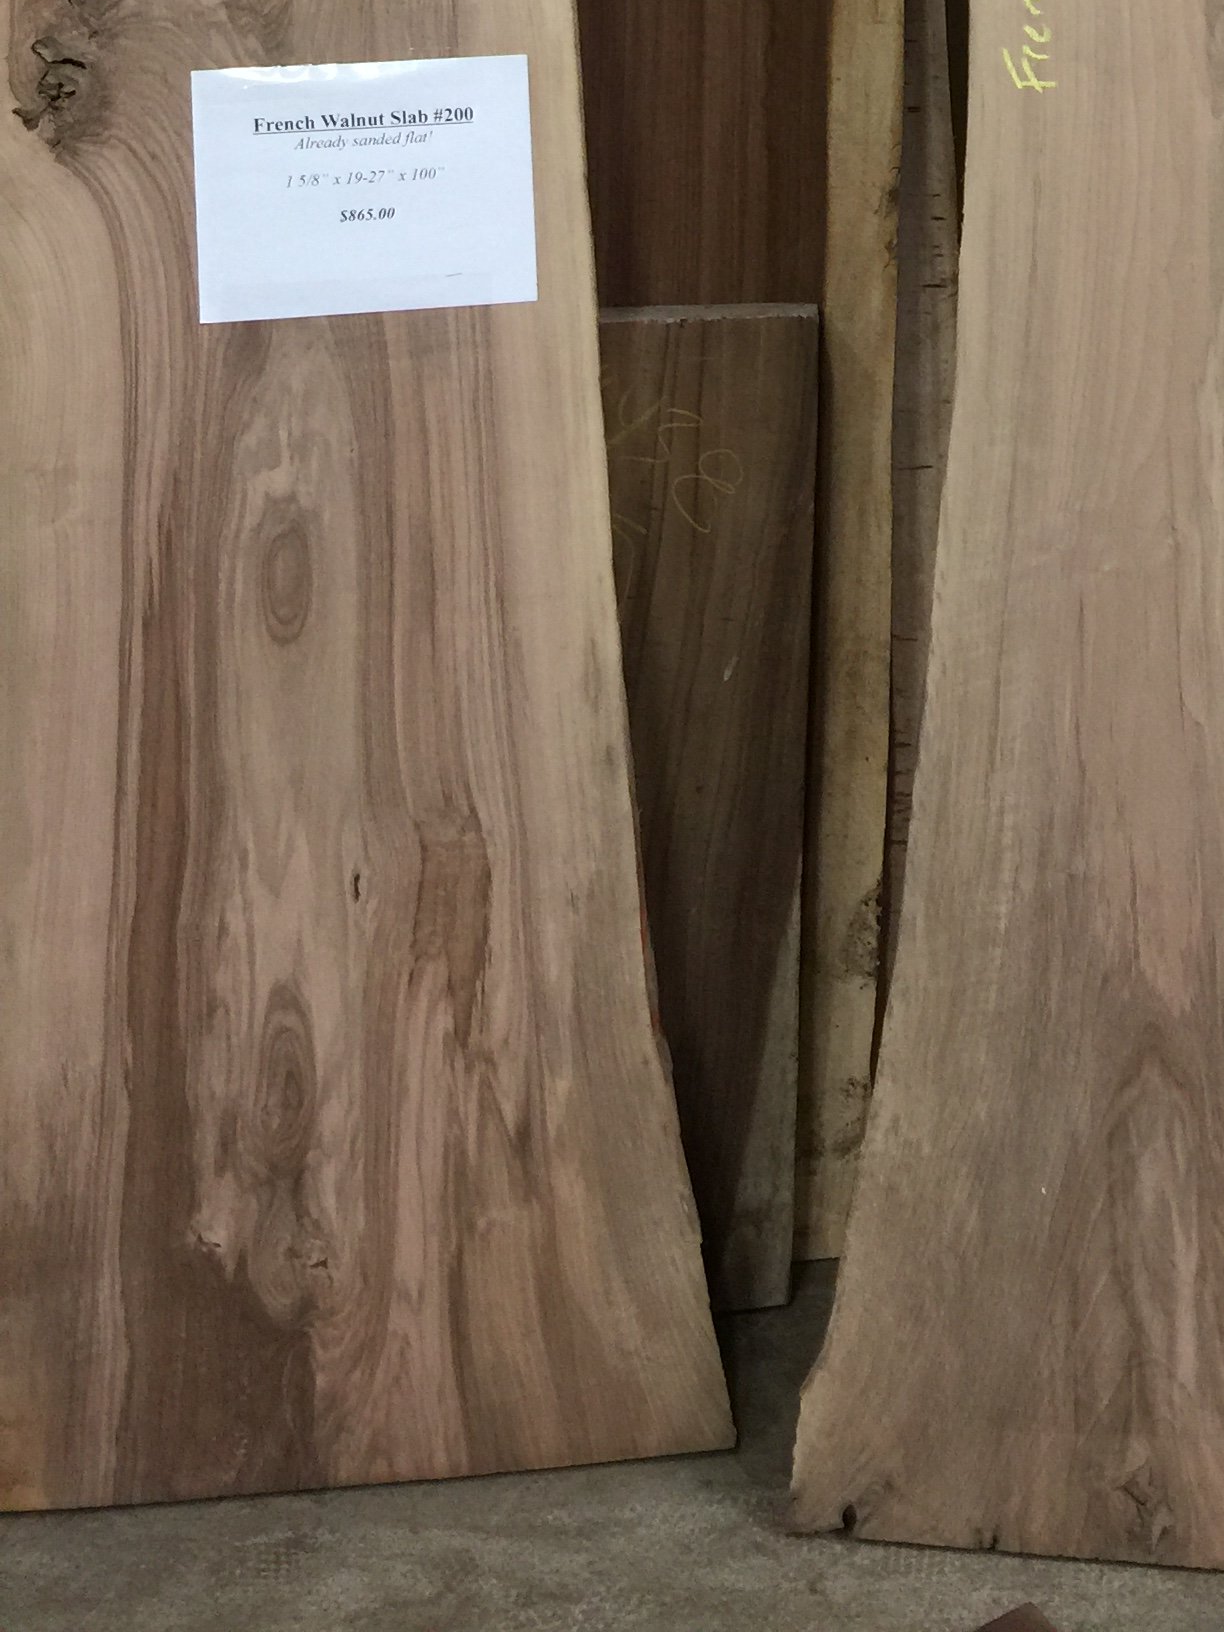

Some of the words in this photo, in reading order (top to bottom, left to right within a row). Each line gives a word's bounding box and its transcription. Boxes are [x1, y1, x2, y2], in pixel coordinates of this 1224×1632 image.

[253, 116, 316, 133] French
[320, 112, 385, 129] Walnut
[390, 109, 429, 126] Slab
[433, 106, 475, 123] #200
[293, 134, 348, 151] Already
[352, 131, 402, 147] sanded
[332, 175, 343, 186] x
[397, 171, 408, 182] x
[339, 206, 396, 224] $865.00
